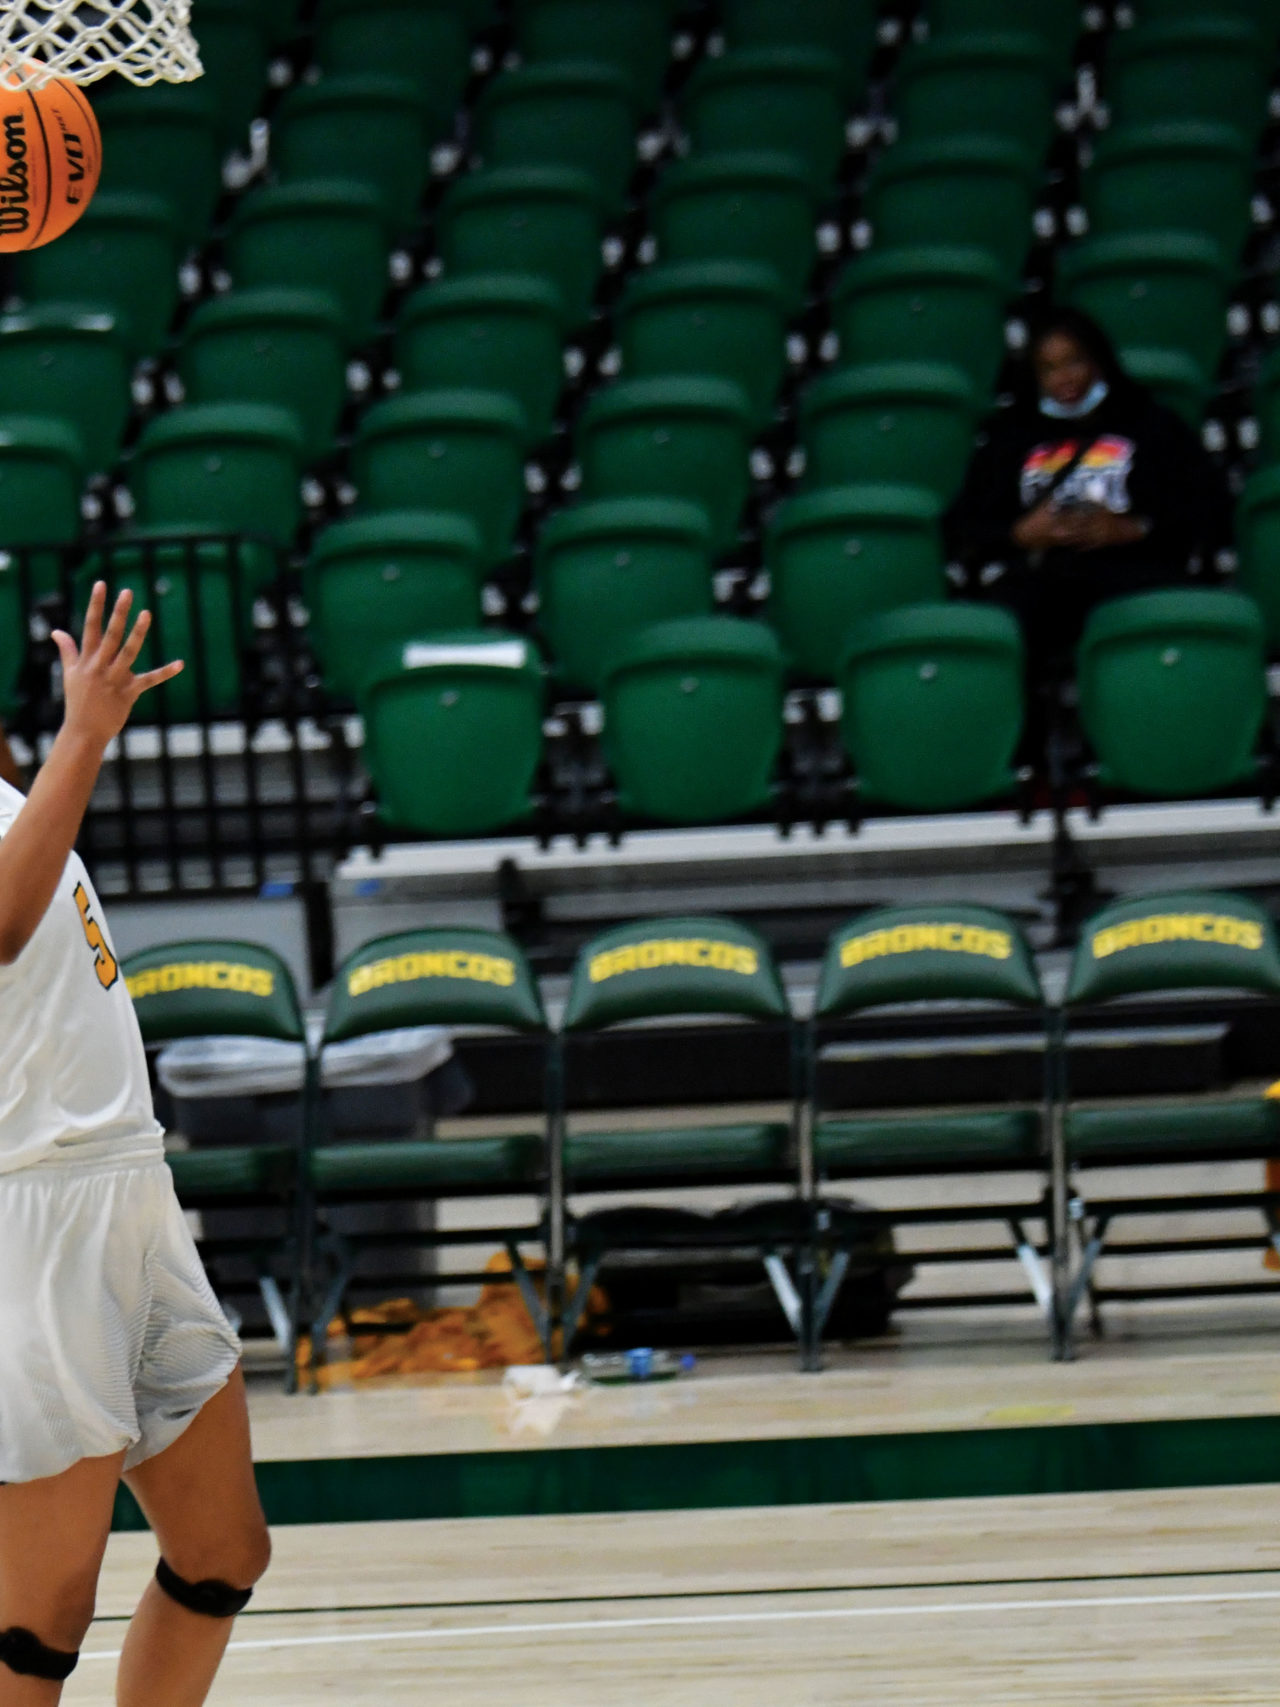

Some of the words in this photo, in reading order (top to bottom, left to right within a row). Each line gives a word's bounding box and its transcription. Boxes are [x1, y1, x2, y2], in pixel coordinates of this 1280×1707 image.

[73, 881, 119, 991] 5
[840, 922, 1011, 968] BRONCOS
[1092, 913, 1264, 959] BRONCOS
[348, 950, 515, 997] BRONCOS
[590, 937, 758, 983] BRONCOS
